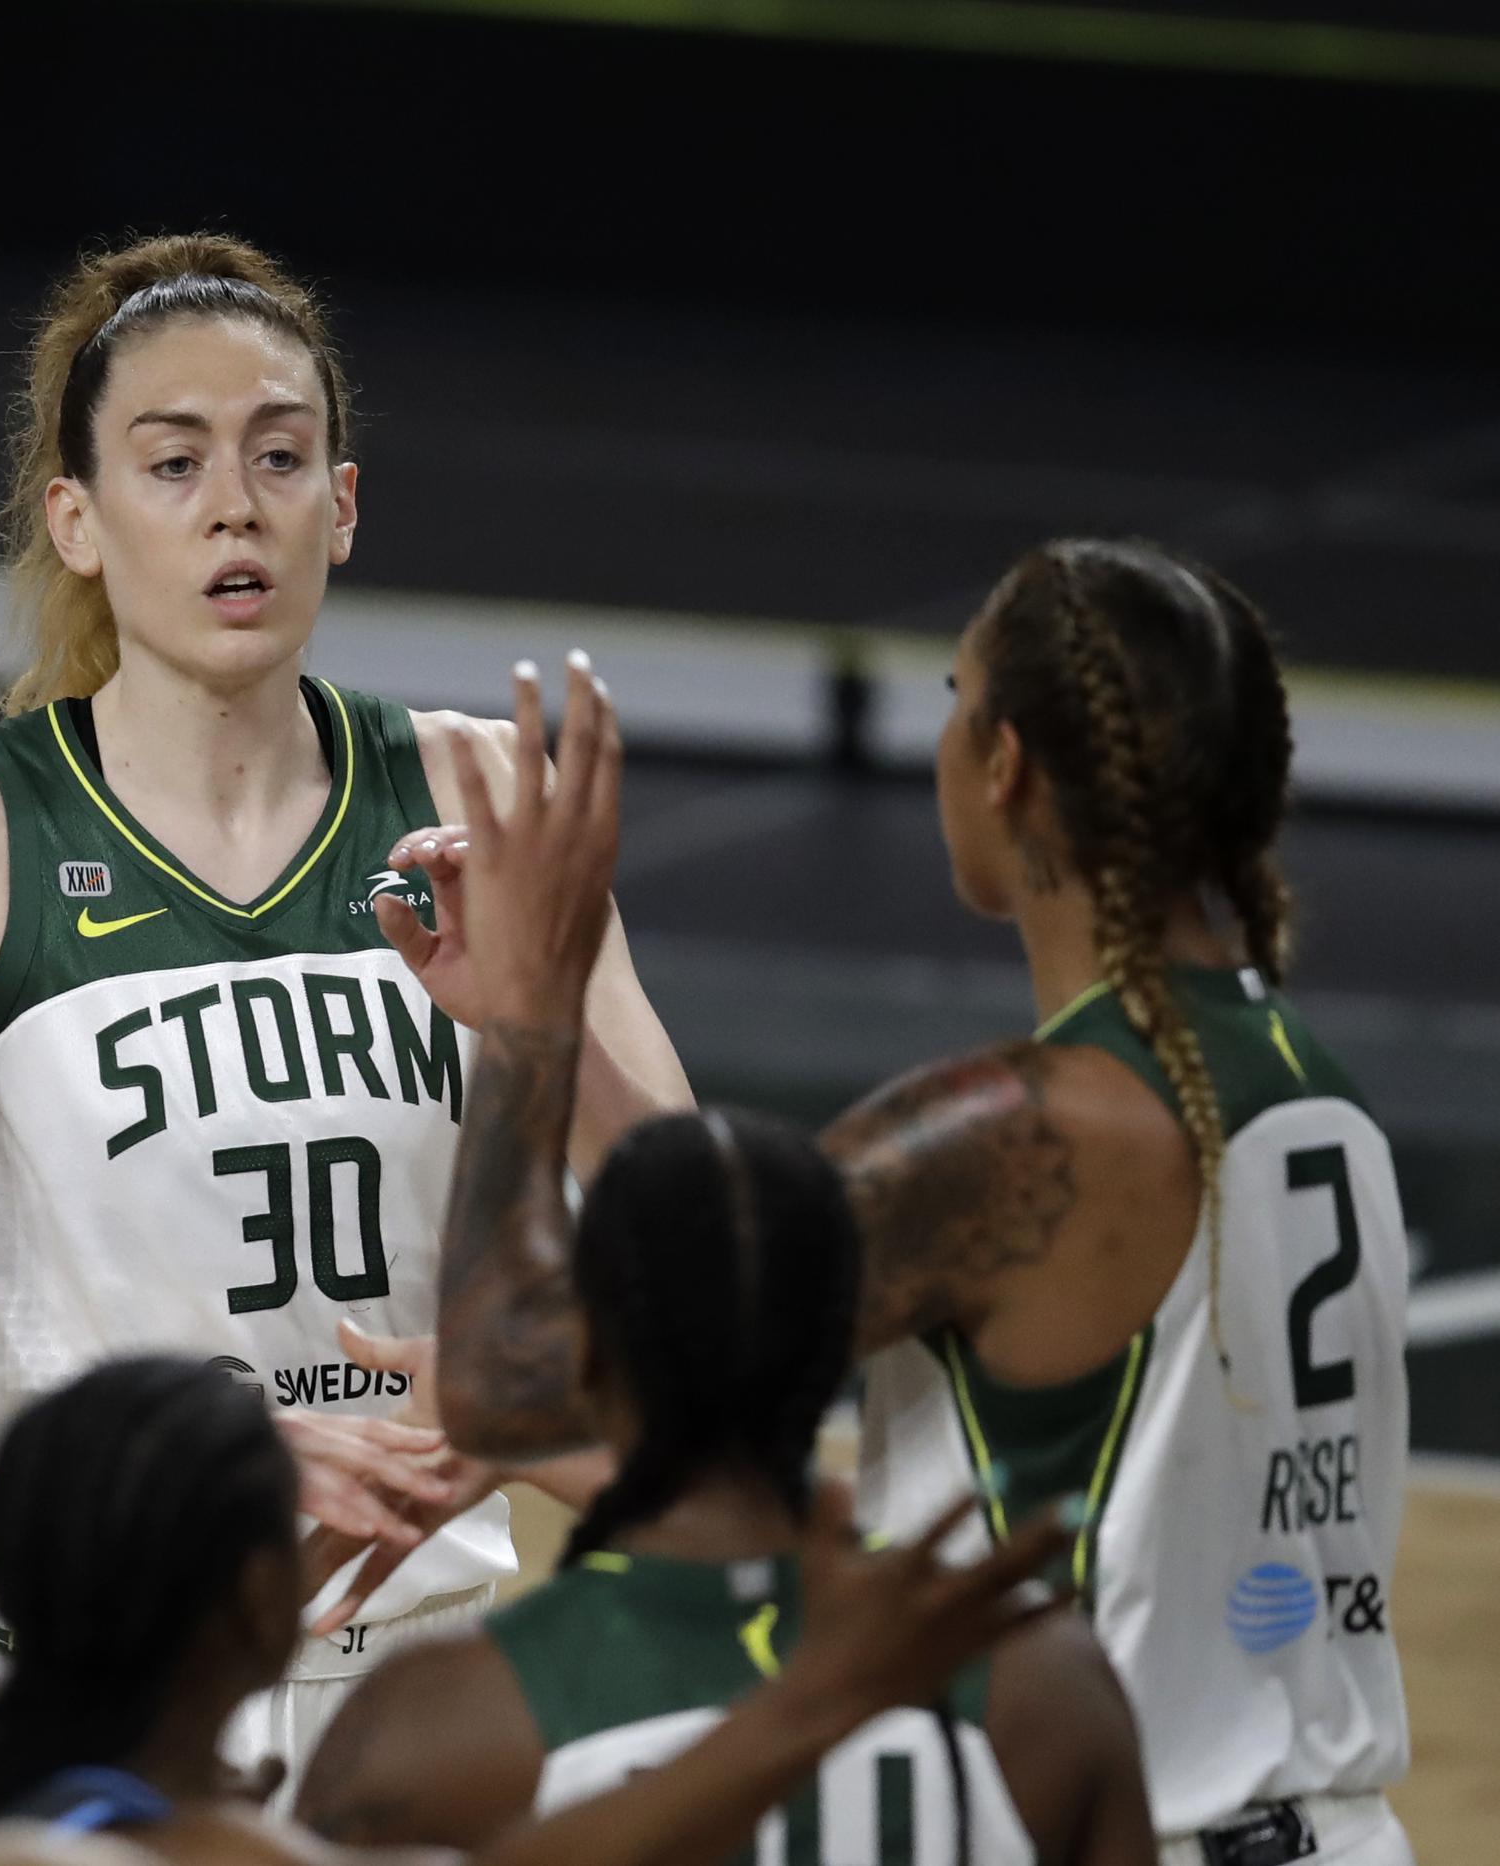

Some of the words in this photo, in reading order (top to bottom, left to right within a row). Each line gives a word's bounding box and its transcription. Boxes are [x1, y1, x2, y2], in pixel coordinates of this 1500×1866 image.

[95, 973, 463, 1160] STORM
[213, 1136, 390, 1314] 30
[1286, 1144, 1362, 1410] 2
[274, 1361, 414, 1407] SWEDIS
